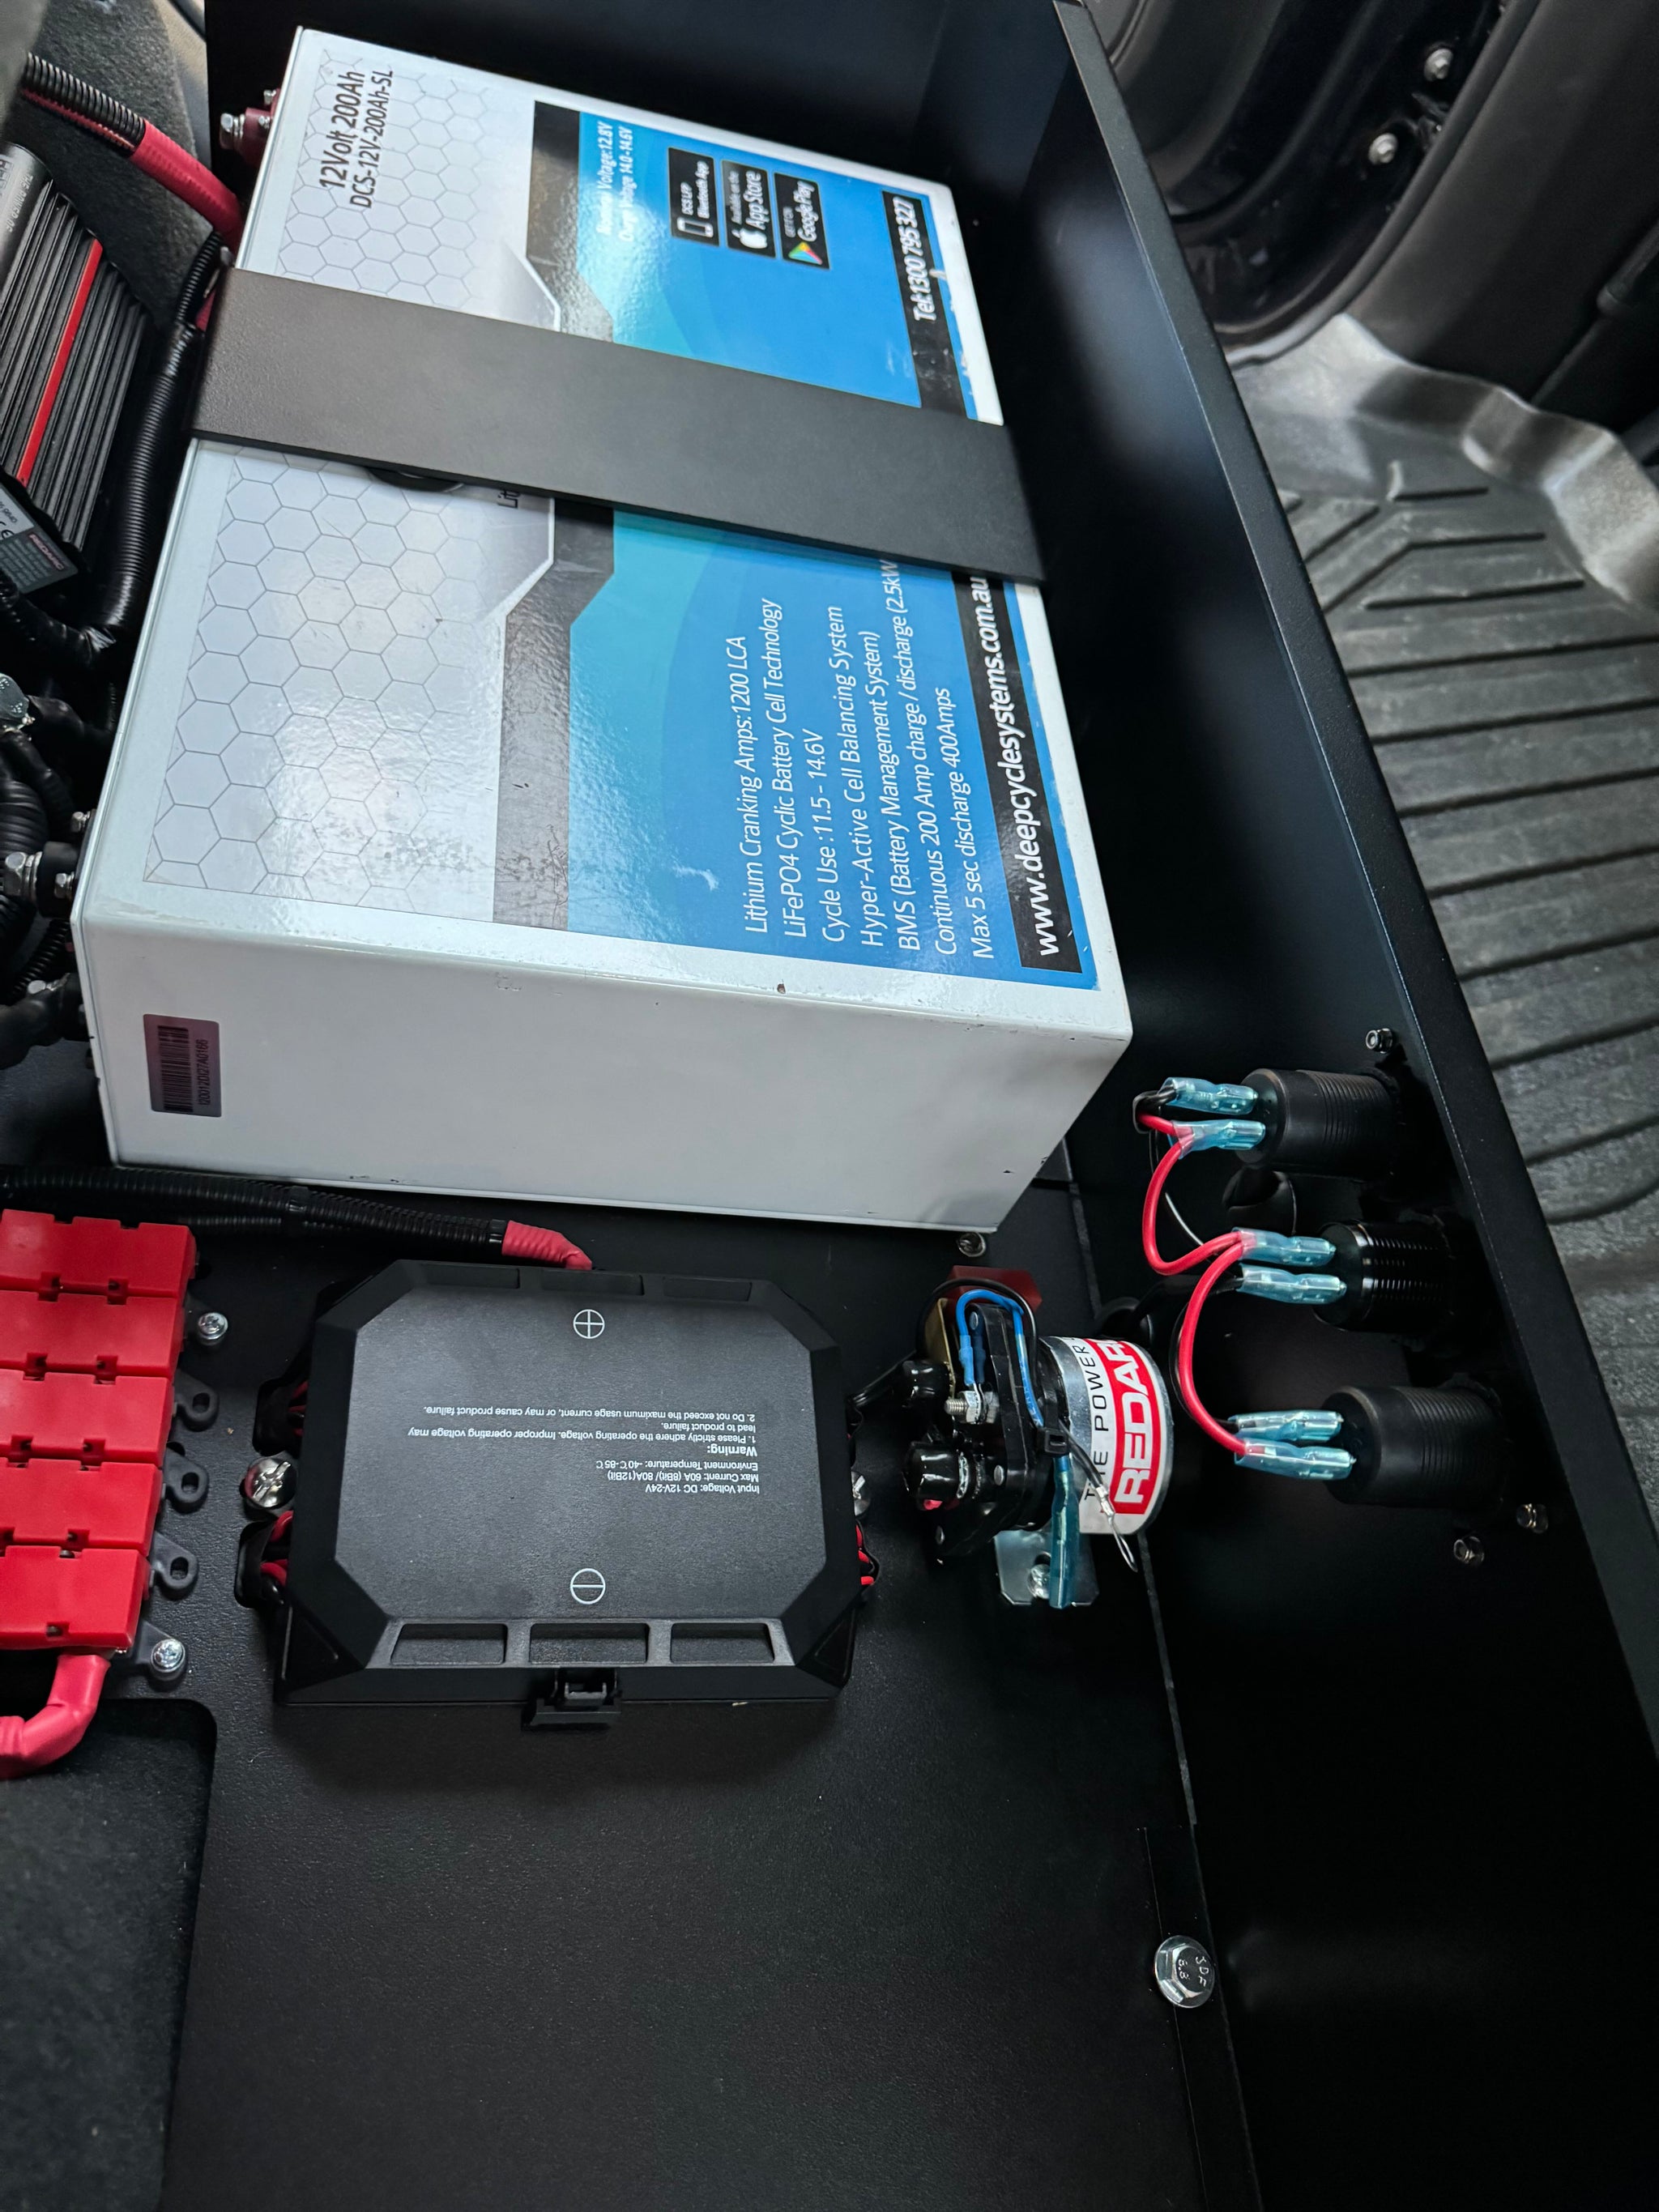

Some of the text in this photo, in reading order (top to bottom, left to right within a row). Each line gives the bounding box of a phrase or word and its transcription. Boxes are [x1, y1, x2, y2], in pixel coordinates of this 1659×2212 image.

[319, 71, 365, 188] 12Volt 200Ah
[350, 70, 393, 208] DCS-12V-200Ah-SL
[695, 160, 710, 179] App
[743, 171, 770, 229] App Store
[793, 181, 819, 241] Google Play
[893, 197, 918, 228] 327
[898, 226, 923, 256] 795
[726, 637, 748, 670] LCA
[892, 616, 916, 690] discharge
[898, 692, 919, 701] /
[905, 703, 927, 760] charge
[803, 728, 827, 778] 14.6V
[758, 598, 807, 937] LiFePO4 Cyclic Battery Cell Technology
[968, 577, 1059, 956] www.deepcyclesystems.com.au
[827, 606, 888, 946] Hyper-Active Cell Balancing System
[859, 631, 920, 950] BMS (Battery Management System)
[914, 765, 935, 808] Amp
[736, 775, 762, 856] Cranking
[935, 688, 994, 958] Max 5 sec discharge 400Amps
[917, 811, 940, 846] 200
[817, 846, 838, 883] Use
[743, 862, 769, 933] Lithium
[926, 850, 957, 955] Continuous
[819, 889, 851, 942] Cycle
[1072, 1345, 1108, 1431] POWER
[424, 1407, 455, 1416] failure.
[457, 1407, 493, 1416] product
[495, 1408, 522, 1416] cause
[525, 1407, 544, 1415] may
[558, 1409, 592, 1417] current,
[595, 1409, 621, 1418] usage
[624, 1411, 666, 1419] maximum
[667, 1412, 682, 1420] the
[684, 1413, 714, 1421] exceed
[716, 1413, 730, 1421] not
[661, 1422, 689, 1430] failure.
[692, 1422, 724, 1431] product
[737, 1425, 756, 1433] lead
[407, 1427, 429, 1436] may
[432, 1428, 466, 1438] voltage
[468, 1429, 512, 1438] operating
[515, 1430, 556, 1439] Improper
[558, 1431, 593, 1440] voltage.
[596, 1431, 638, 1440] operating
[655, 1434, 686, 1442] adhere
[688, 1433, 715, 1443] strictly
[717, 1434, 746, 1443] Please
[748, 1435, 756, 1443] 1.
[707, 1443, 757, 1456] Warning:
[645, 1460, 702, 1470] Temperature:
[704, 1461, 758, 1471] Environment
[608, 1470, 759, 1482] Max Current: 60A (8Bit)/ 80A(12Bit)
[645, 1484, 760, 1494] Input Voltage: DC 12V-24V
